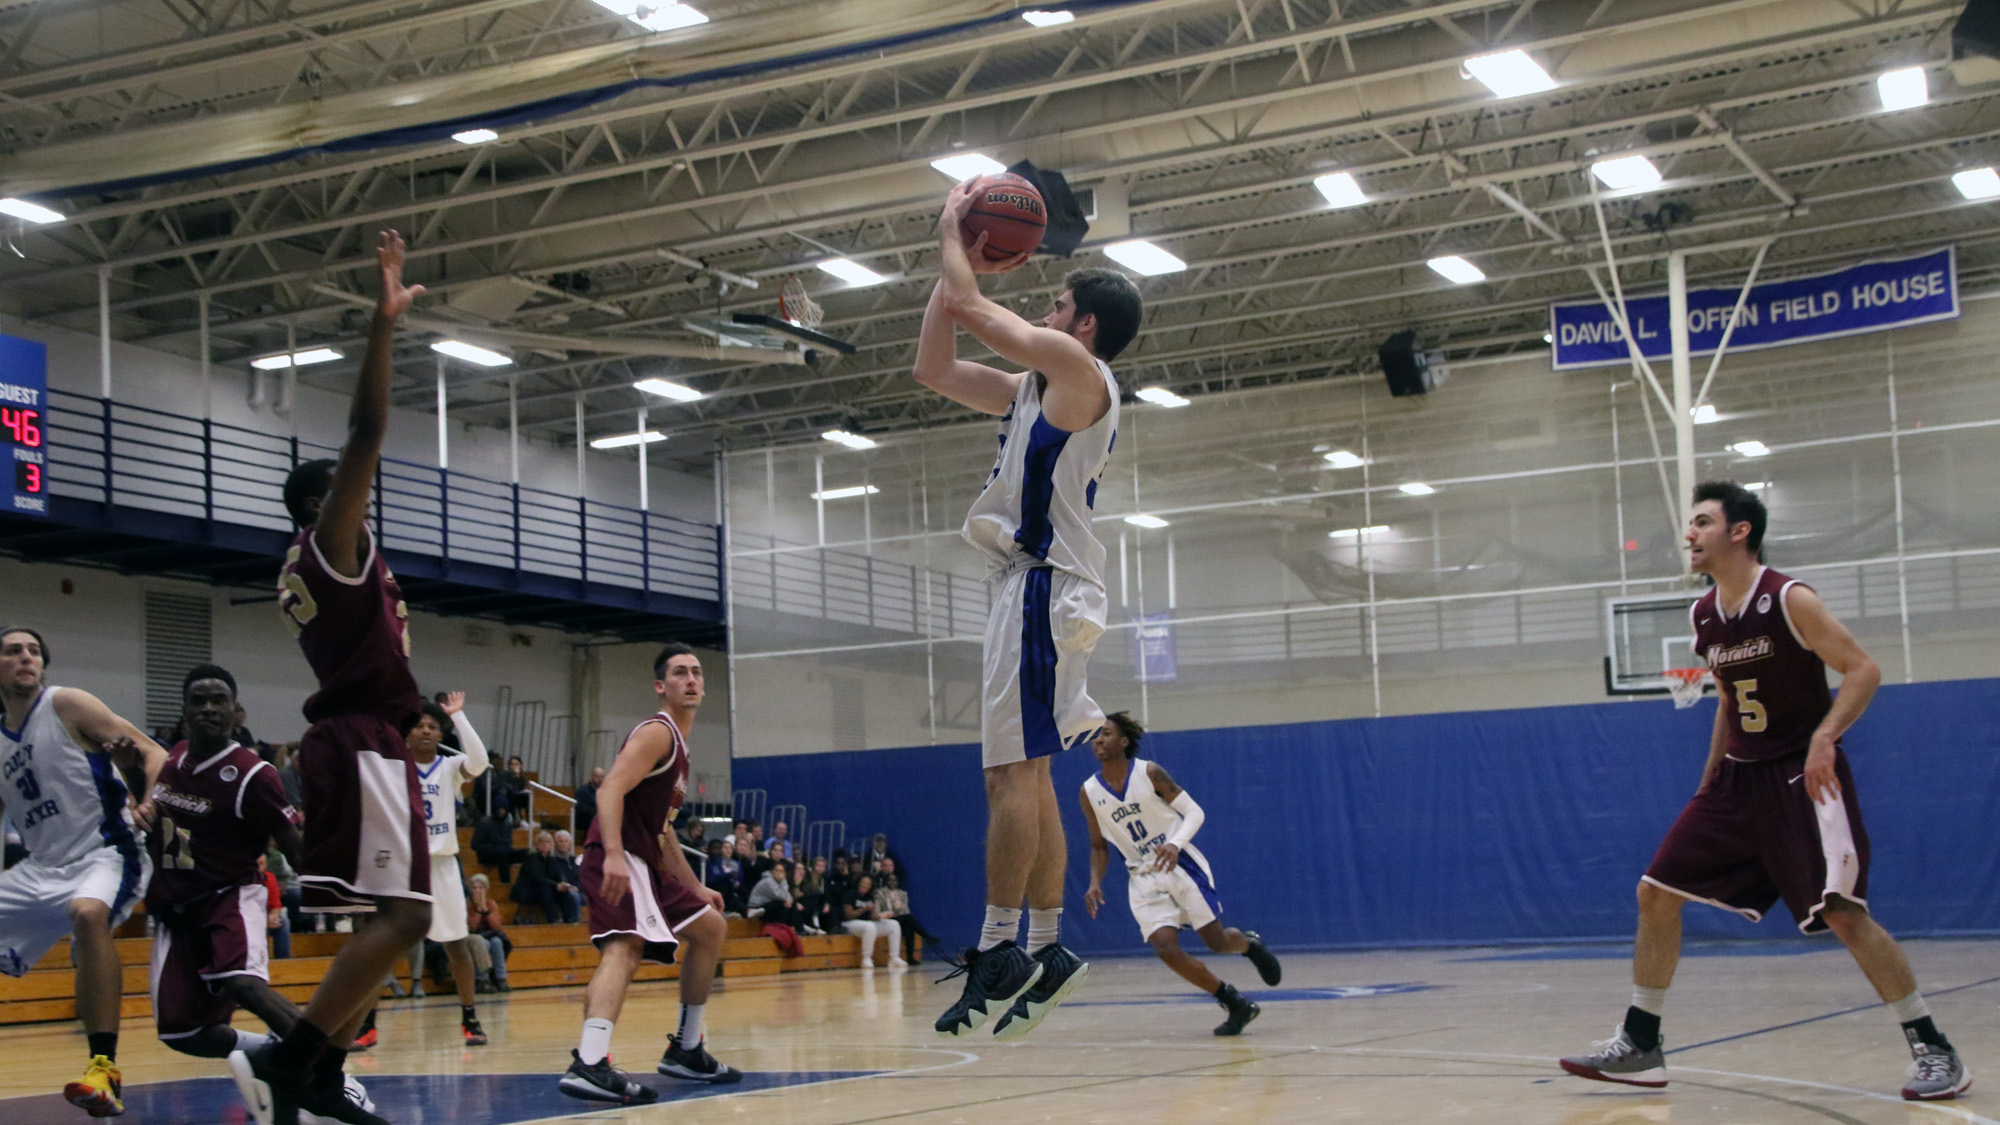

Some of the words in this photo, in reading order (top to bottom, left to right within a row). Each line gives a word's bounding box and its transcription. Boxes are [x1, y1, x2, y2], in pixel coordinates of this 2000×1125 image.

[987, 193, 1043, 217] Wilson
[1561, 321, 1626, 346] DAVID
[1638, 316, 1658, 340] L.
[1670, 303, 1759, 338] OFFIN
[1770, 291, 1840, 323] FIELD
[1852, 271, 1946, 309] HOUSE
[2, 408, 40, 447] 46
[26, 463, 40, 492] 3
[1707, 635, 1773, 671] Norwich
[1733, 678, 1768, 733] 5
[1126, 819, 1148, 842] 10
